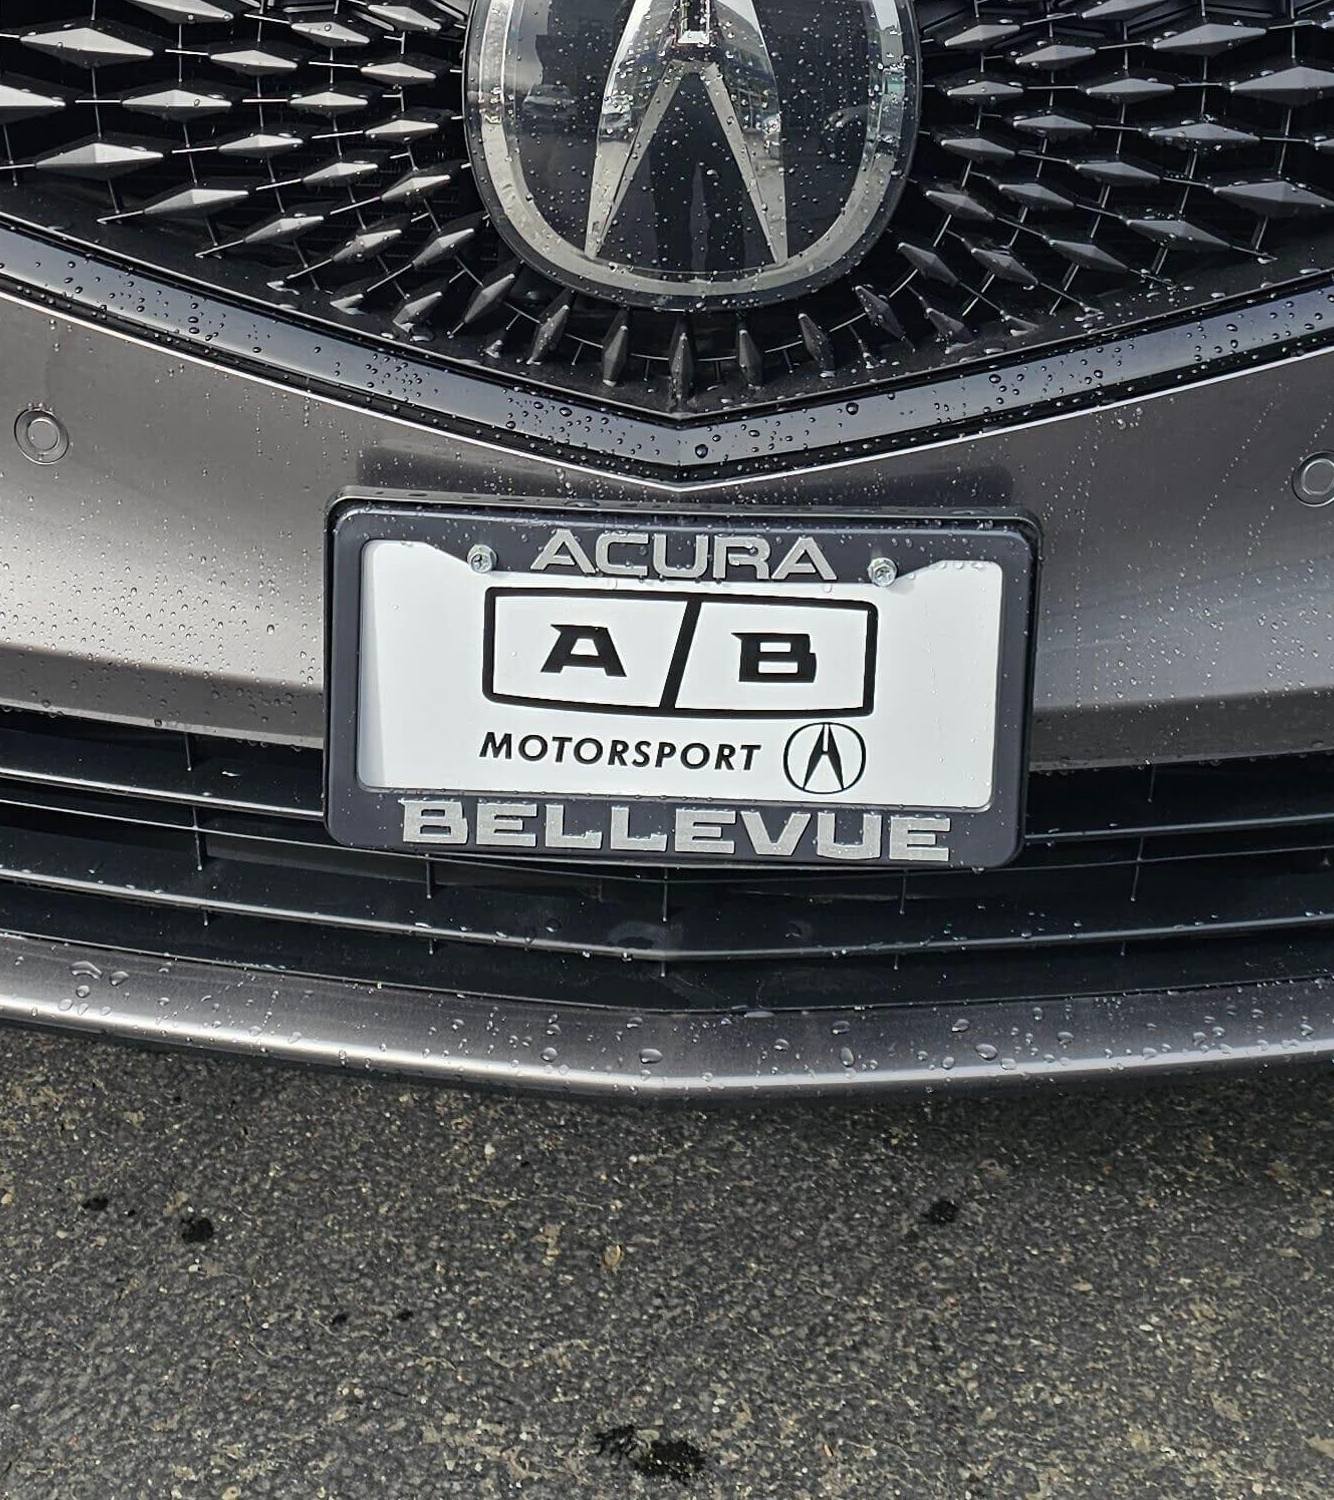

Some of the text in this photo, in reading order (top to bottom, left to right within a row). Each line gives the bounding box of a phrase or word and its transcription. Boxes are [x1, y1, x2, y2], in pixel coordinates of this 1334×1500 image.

[530, 528, 838, 581] ACURA
[478, 731, 762, 771] MOTORSPORT
[399, 798, 951, 862] BELLEVUE
